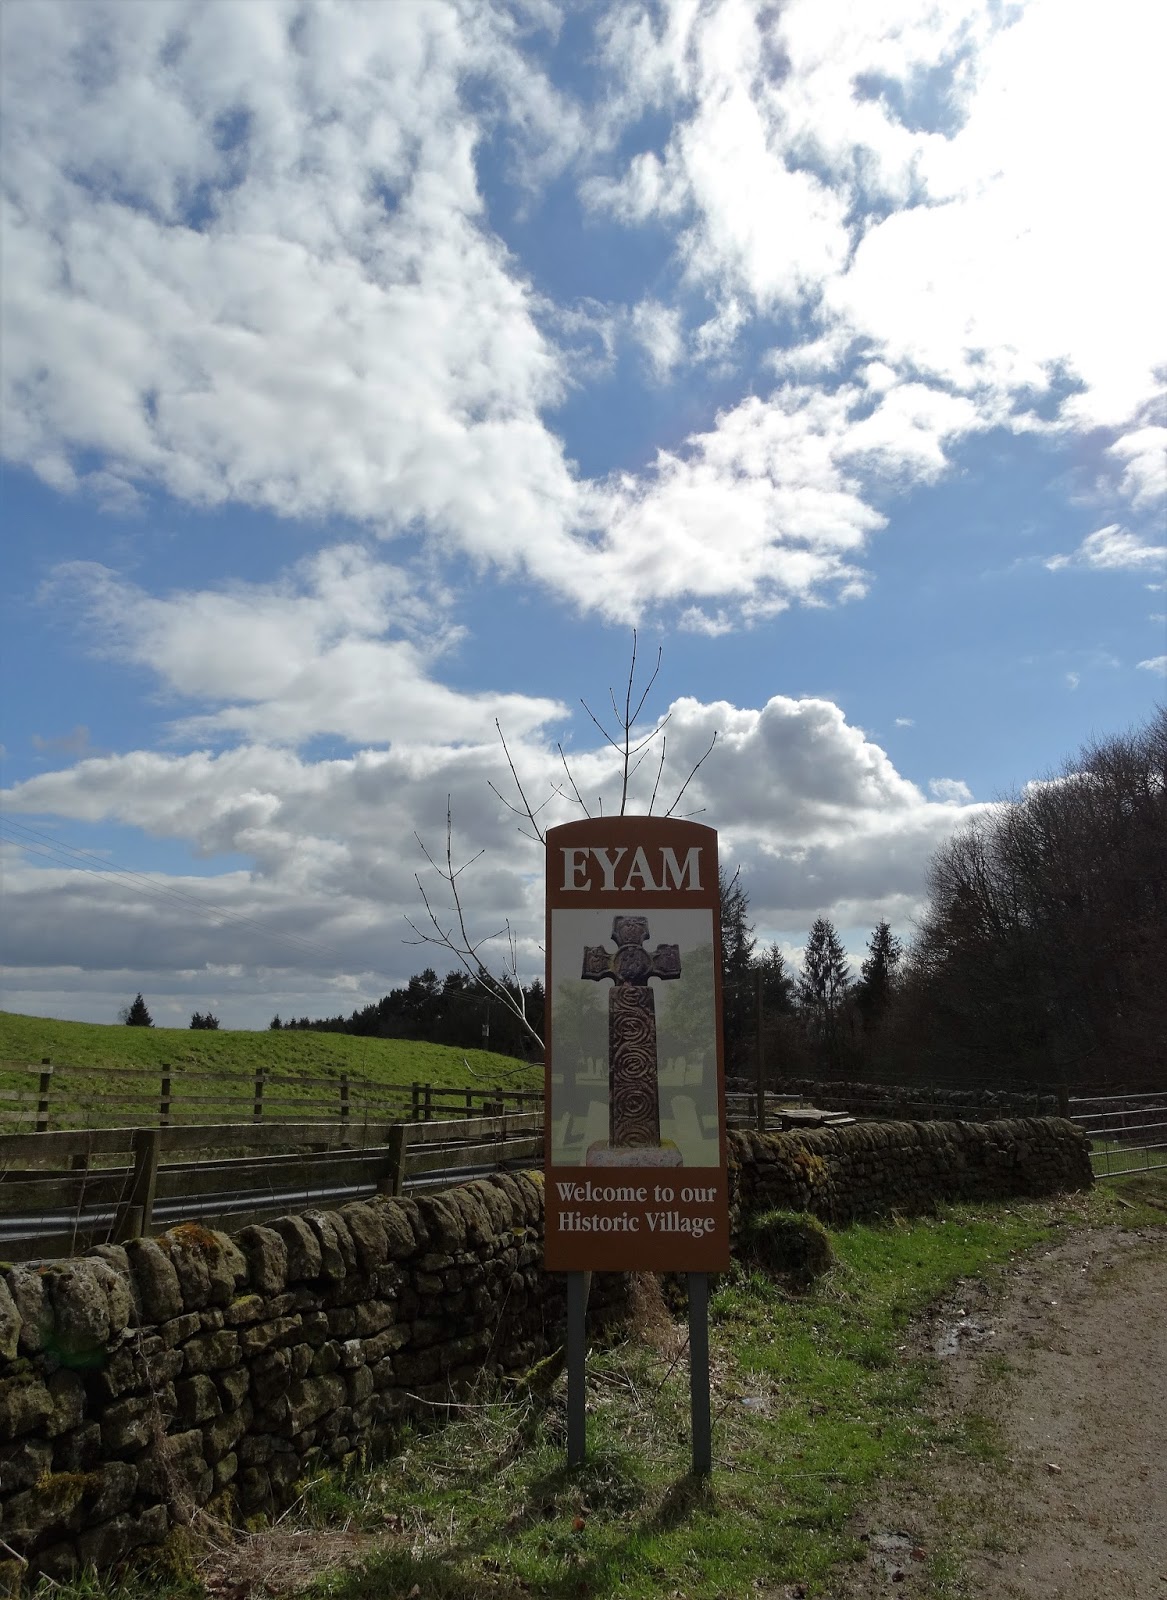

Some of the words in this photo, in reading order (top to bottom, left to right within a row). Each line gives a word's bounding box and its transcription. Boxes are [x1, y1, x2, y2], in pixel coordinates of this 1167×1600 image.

[559, 846, 705, 891] EYAM
[555, 1181, 648, 1202] Welcome
[653, 1185, 675, 1202] to
[680, 1186, 717, 1202] our
[558, 1211, 640, 1232] Historic
[644, 1211, 716, 1238] Village
